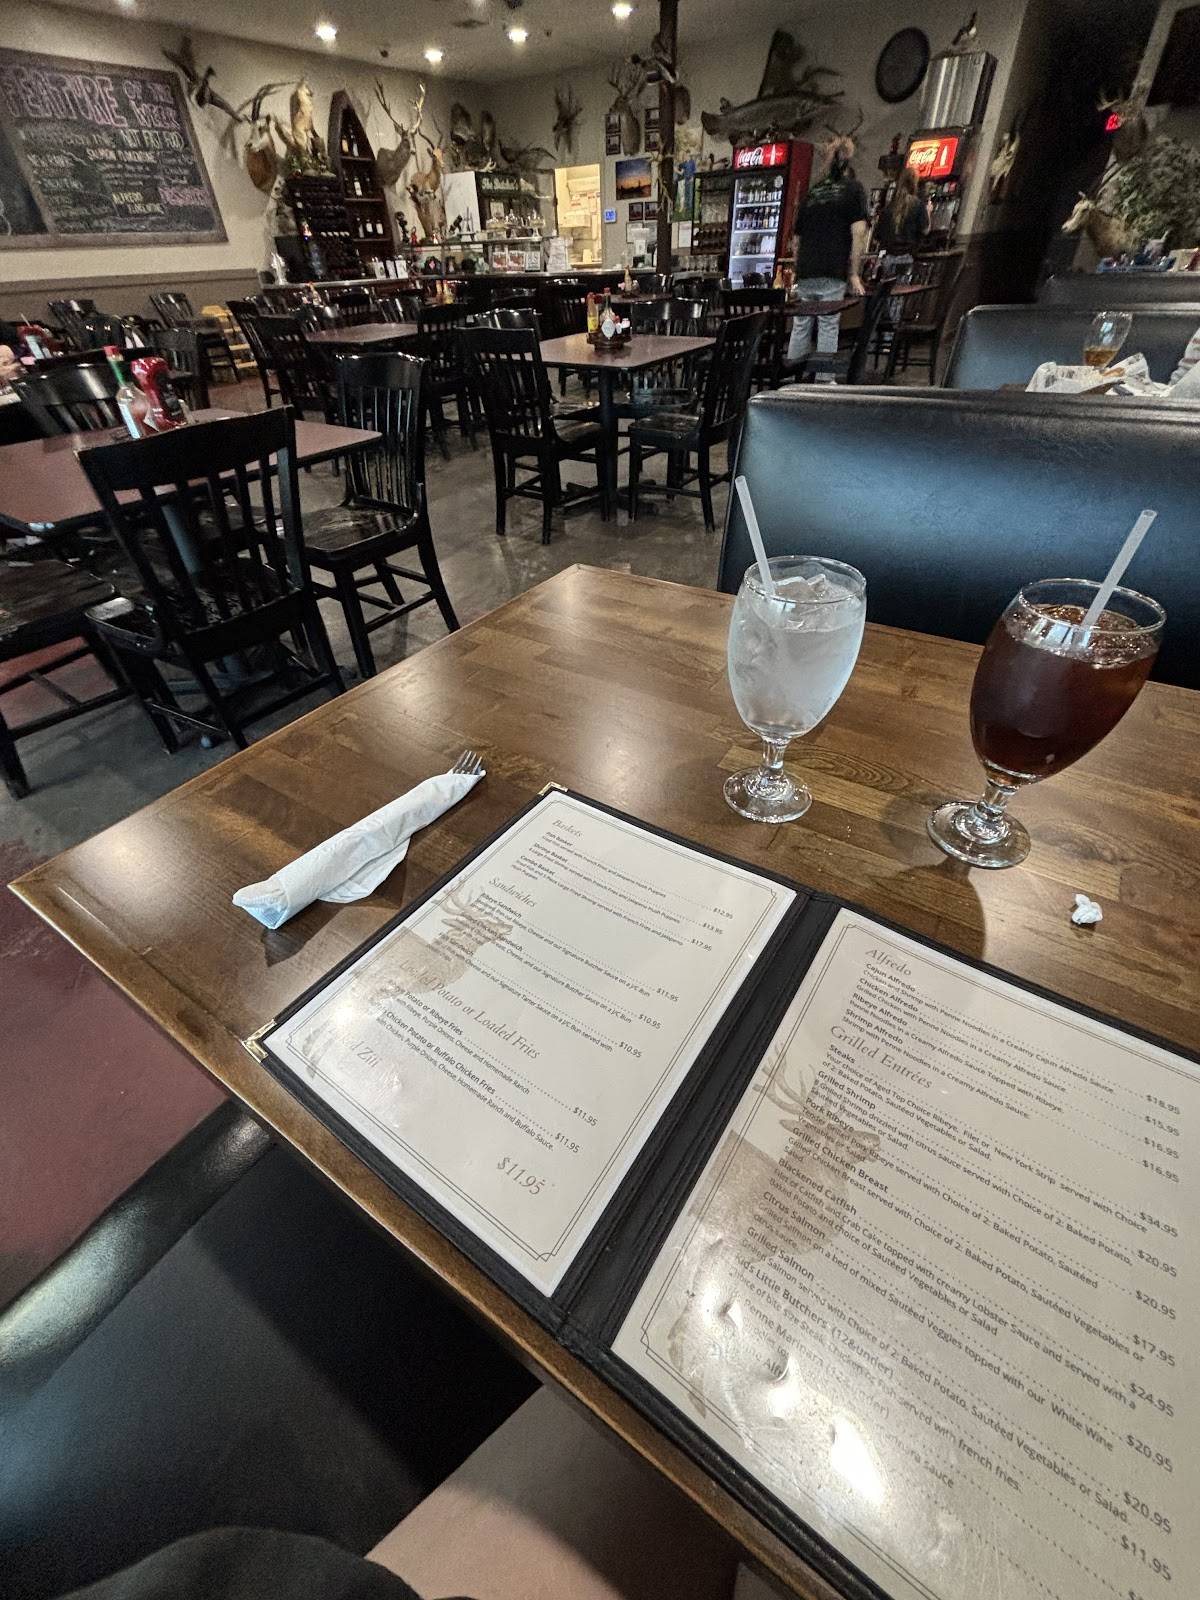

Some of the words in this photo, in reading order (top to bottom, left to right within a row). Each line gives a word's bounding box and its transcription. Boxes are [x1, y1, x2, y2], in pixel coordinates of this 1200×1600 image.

[4, 68, 128, 127] FEATURE
[129, 100, 181, 129] WEEK
[486, 876, 541, 908] Sandwiches
[550, 819, 586, 837] Baskets
[495, 901, 523, 918] Sandwich
[655, 986, 679, 1002] $11.95
[495, 933, 525, 952] Sandwich
[638, 1012, 661, 1029] $10.95
[690, 937, 712, 951] $17.95
[863, 944, 915, 977] Alfredo
[384, 1010, 410, 1030] Chicken
[405, 1026, 429, 1045] Potato
[432, 1045, 458, 1066] Buffalo
[453, 1060, 482, 1083] Chicken
[478, 1078, 497, 1095] Fries
[553, 1131, 580, 1154] $11.95
[402, 991, 424, 1007] Potato
[426, 1008, 451, 1027] Ribeye
[446, 1021, 465, 1036] Fries
[571, 1105, 598, 1127] $11.95
[429, 981, 466, 1009] Potato
[461, 1004, 475, 1016] or
[472, 1009, 516, 1042] Loaded
[511, 1034, 542, 1059] Fries
[453, 1038, 475, 1056] Cheese
[471, 1051, 485, 1063] and
[481, 1058, 514, 1084] Homemade
[511, 1079, 531, 1095] Ranch
[617, 1040, 642, 1058] $10.95
[827, 1023, 880, 1061] Grilled
[879, 1051, 934, 1090] Entrées
[851, 992, 879, 1011] Ribeye
[877, 1006, 909, 1026] Alfredo
[1143, 1135, 1179, 1160] $16.95
[858, 977, 890, 997] Chicken
[888, 992, 919, 1012] Alfredo
[1145, 1114, 1179, 1138] $15.95
[865, 962, 888, 978] Cajun
[887, 973, 916, 992] Alfredo
[1146, 1093, 1180, 1116] $18.95
[455, 1075, 489, 1103] Homemade
[485, 1097, 506, 1115] Ranch
[502, 1110, 517, 1123] and
[513, 1117, 537, 1138] Buffalo
[825, 1052, 842, 1066] Your
[840, 1062, 865, 1080] choice
[863, 1074, 872, 1084] of
[871, 1079, 891, 1096] Aged
[891, 1090, 906, 1105] Top
[905, 1098, 931, 1118] Choice
[962, 1129, 980, 1144] Filet
[993, 1146, 1013, 1162] New
[1014, 1156, 1034, 1173] York
[1034, 1167, 1056, 1187] Strip
[1060, 1180, 1090, 1204] served
[1092, 1198, 1113, 1216] with
[1114, 1209, 1147, 1235] Choice
[828, 1044, 856, 1064] Steaks
[1139, 1210, 1177, 1239] $34.95
[843, 1007, 874, 1030] Shrimp
[872, 1023, 904, 1045] Alfredo
[1142, 1158, 1178, 1184] $16.95
[494, 1151, 546, 1200] $11.95
[804, 1097, 826, 1115] Pork
[824, 1109, 855, 1135] Ribeye
[1135, 1288, 1176, 1321] $20.95
[816, 1069, 845, 1091] Grilled
[844, 1085, 877, 1111] Shrimp
[1137, 1248, 1176, 1278] $20.95
[777, 1156, 824, 1194] Blackened
[823, 1187, 858, 1217] Catfish
[1129, 1379, 1173, 1420] $24.95
[791, 1126, 821, 1150] Grilled
[820, 1144, 857, 1174] Chicken
[857, 1168, 889, 1194] Breast
[1132, 1332, 1175, 1368] $17.95
[797, 1185, 825, 1208] Catfish
[841, 1213, 861, 1233] Crab
[861, 1226, 883, 1247] Cake
[882, 1241, 914, 1270] topped
[914, 1261, 935, 1282] with
[935, 1275, 970, 1306] creamy
[971, 1297, 1008, 1330] Lobster
[1009, 1321, 1040, 1351] Sauce
[1042, 1342, 1062, 1364] and
[1064, 1356, 1099, 1389] served
[1101, 1380, 1126, 1407] with
[745, 1225, 778, 1255] Grilled
[777, 1248, 816, 1282] Salmon
[1123, 1488, 1171, 1537] $20.95
[762, 1189, 791, 1216] Citrus
[789, 1208, 827, 1240] Salmon
[1126, 1431, 1172, 1475] $20.95
[830, 1252, 848, 1271] bed
[848, 1264, 859, 1278] of
[859, 1271, 887, 1298] mixed
[887, 1290, 925, 1325] Sautéed
[925, 1317, 963, 1353] Veggies
[963, 1343, 1000, 1378] topped
[1001, 1368, 1025, 1393] with
[1026, 1387, 1045, 1408] our
[1050, 1400, 1083, 1433] White
[1084, 1423, 1113, 1454] Wine
[754, 1267, 782, 1295] Little
[780, 1287, 829, 1331] Butchers
[1120, 1532, 1171, 1585] $11.95
